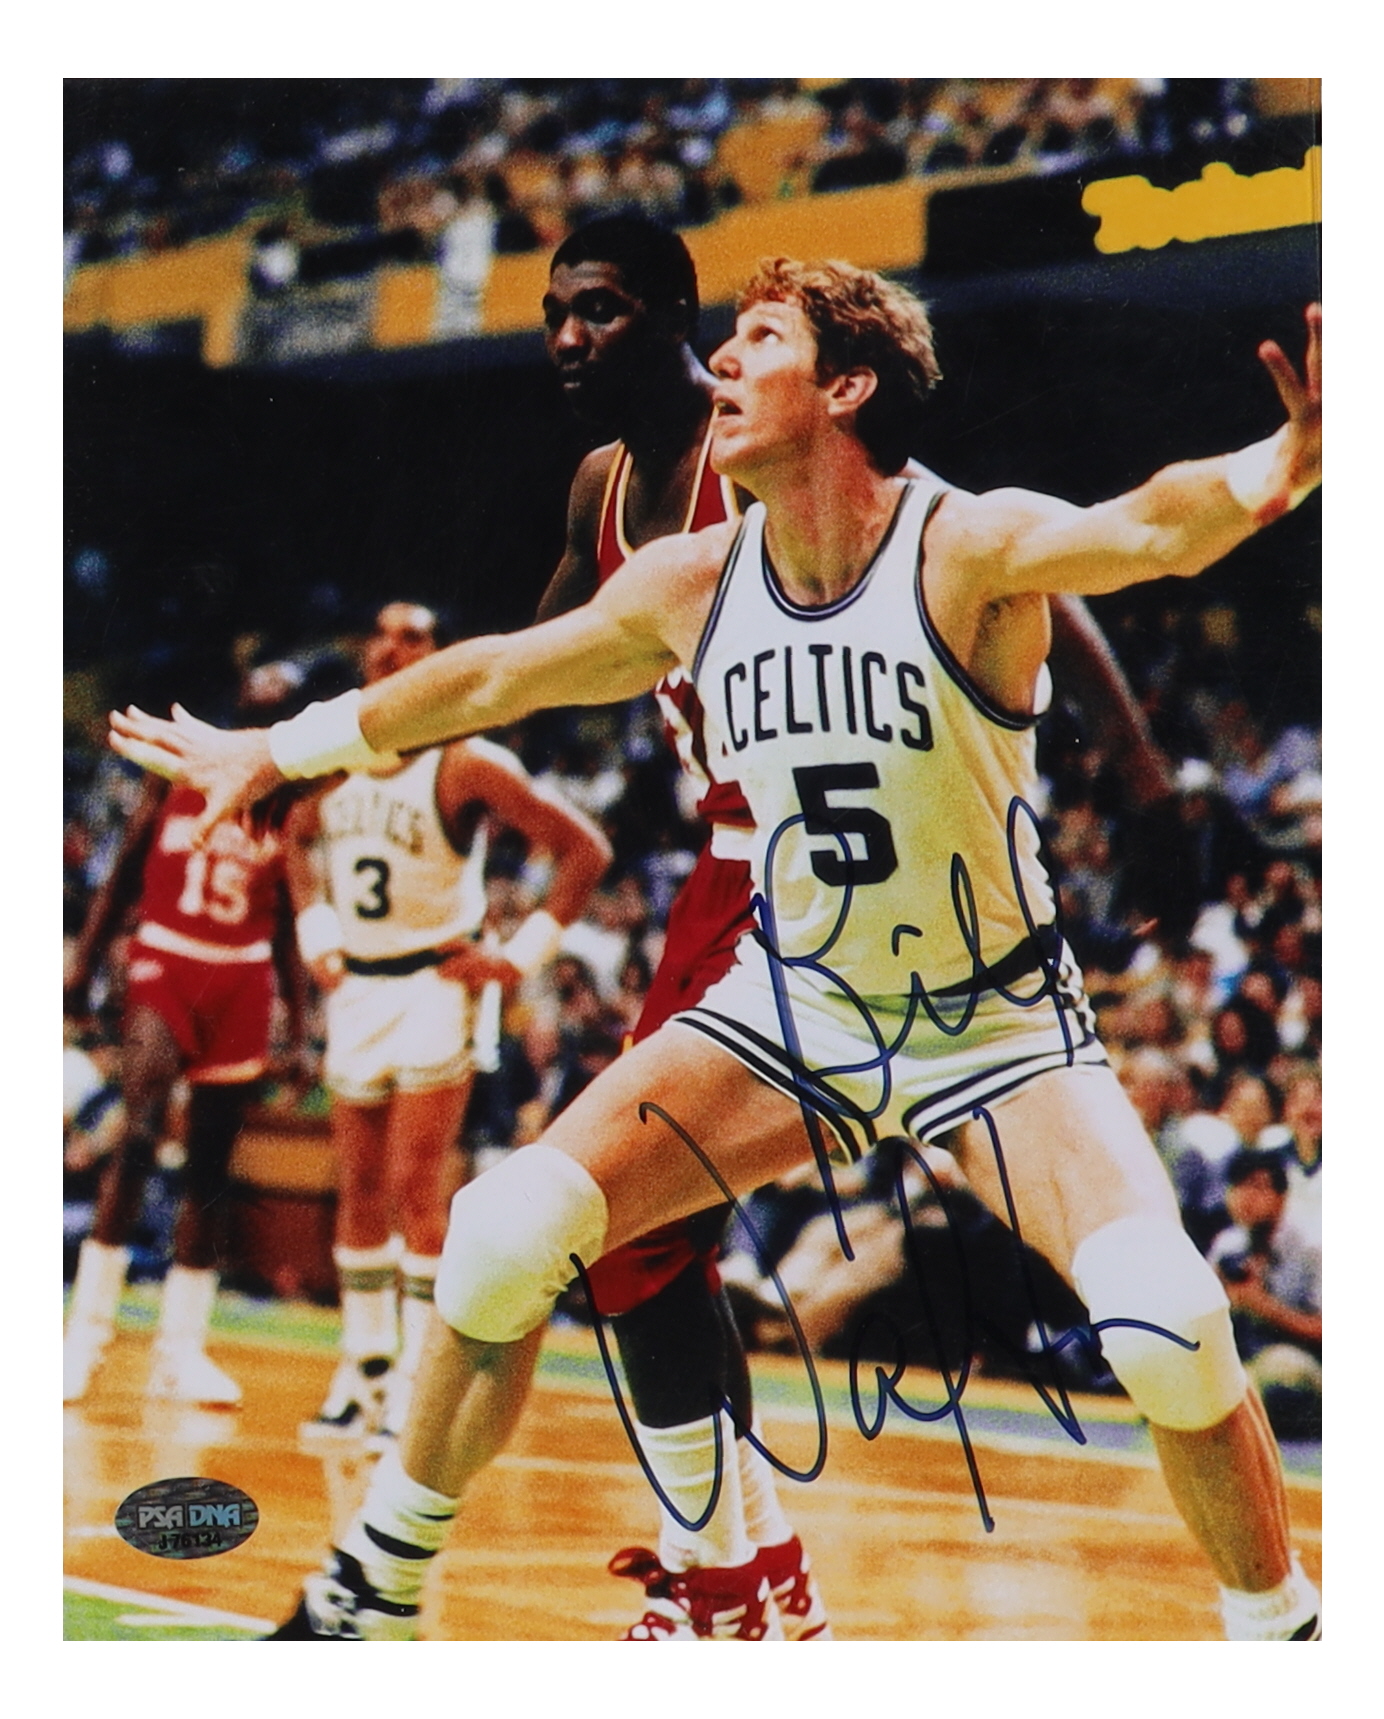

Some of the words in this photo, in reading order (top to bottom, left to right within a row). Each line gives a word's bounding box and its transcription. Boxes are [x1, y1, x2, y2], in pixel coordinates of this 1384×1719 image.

[724, 644, 934, 752] CELTICS
[792, 762, 898, 886] 5
[176, 851, 249, 925] 15
[354, 857, 390, 919] 3
[749, 796, 1074, 1262] Bill
[138, 1504, 184, 1529] PSA
[188, 1503, 241, 1528] DNA
